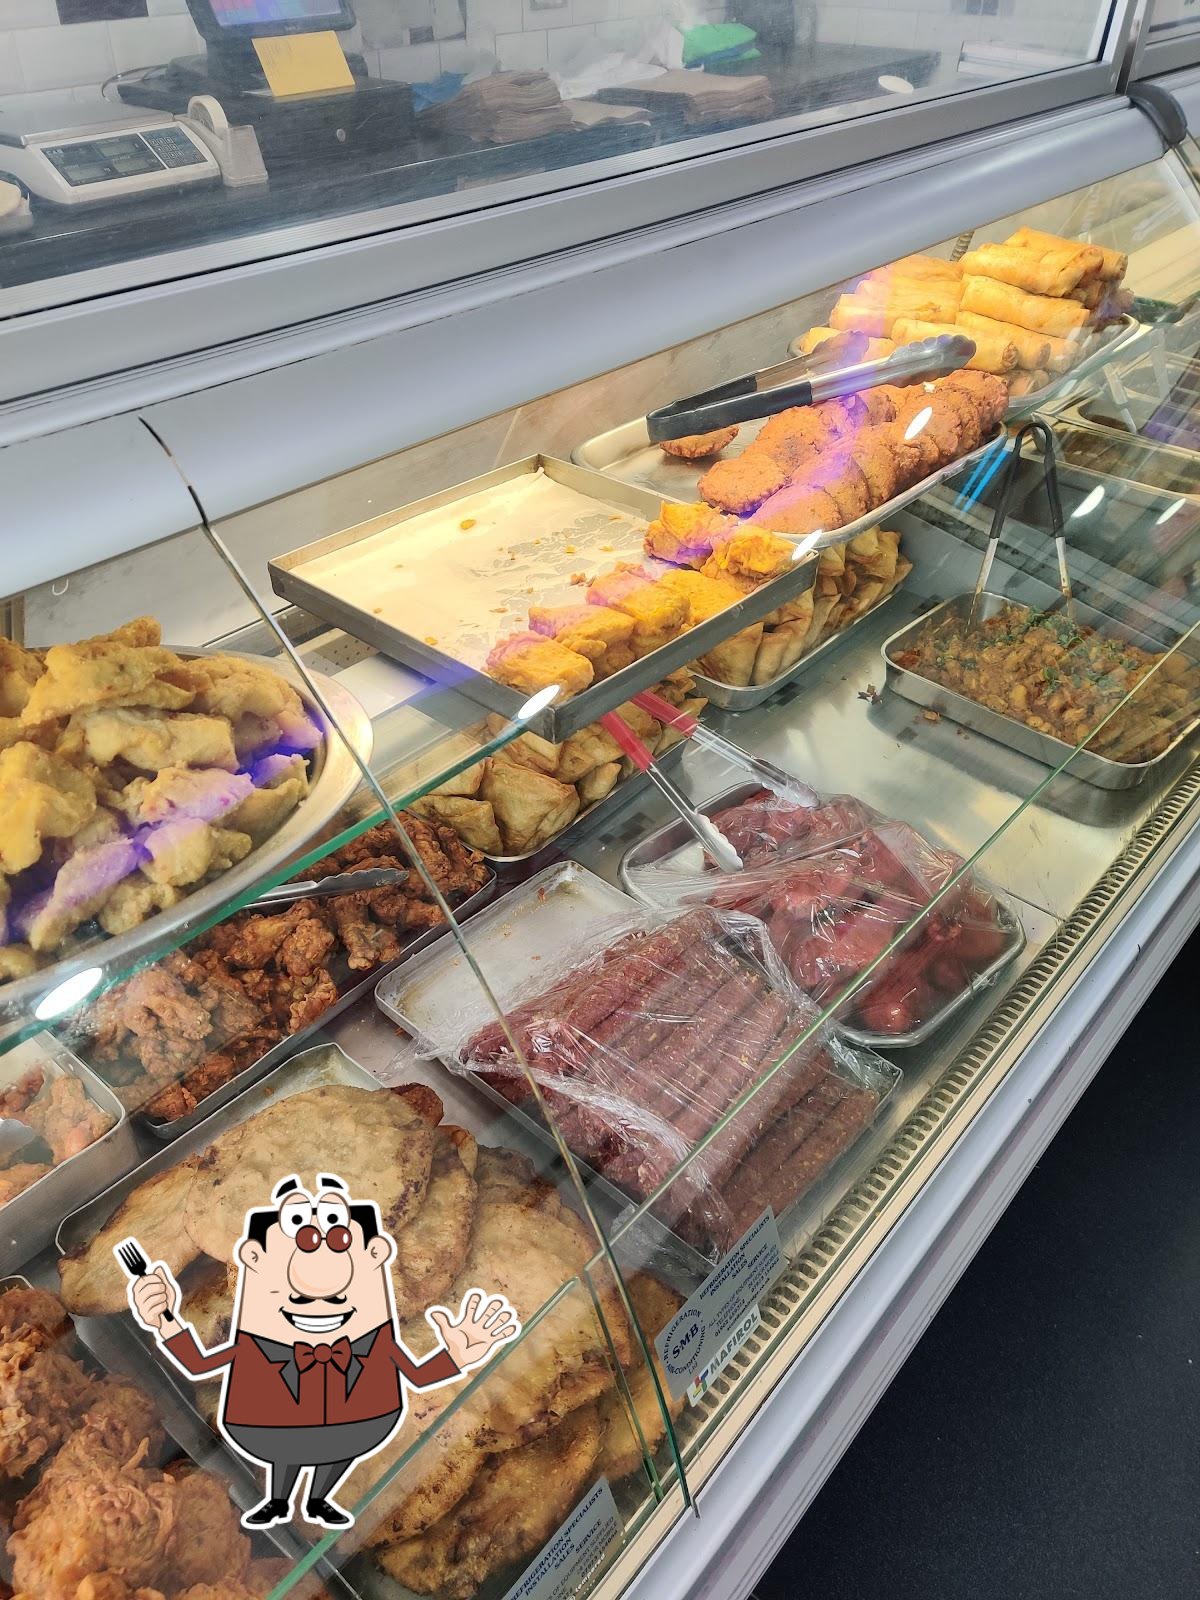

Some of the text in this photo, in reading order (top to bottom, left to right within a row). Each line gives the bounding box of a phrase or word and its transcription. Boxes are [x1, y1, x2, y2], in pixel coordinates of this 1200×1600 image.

[699, 1216, 769, 1299] REFRIGERATION SPECIALISTS
[710, 1253, 745, 1296] INSTALLATION
[732, 1259, 748, 1279] SALES
[747, 1243, 768, 1269] SERVICE
[663, 1308, 702, 1361] REFRIGERATION
[710, 1312, 758, 1375] MAFIROL
[563, 1488, 603, 1537] SPECIALISTS
[554, 1543, 575, 1570] SALES
[575, 1519, 601, 1554] SERVICE
[525, 1536, 572, 1597] INSTALLATION
